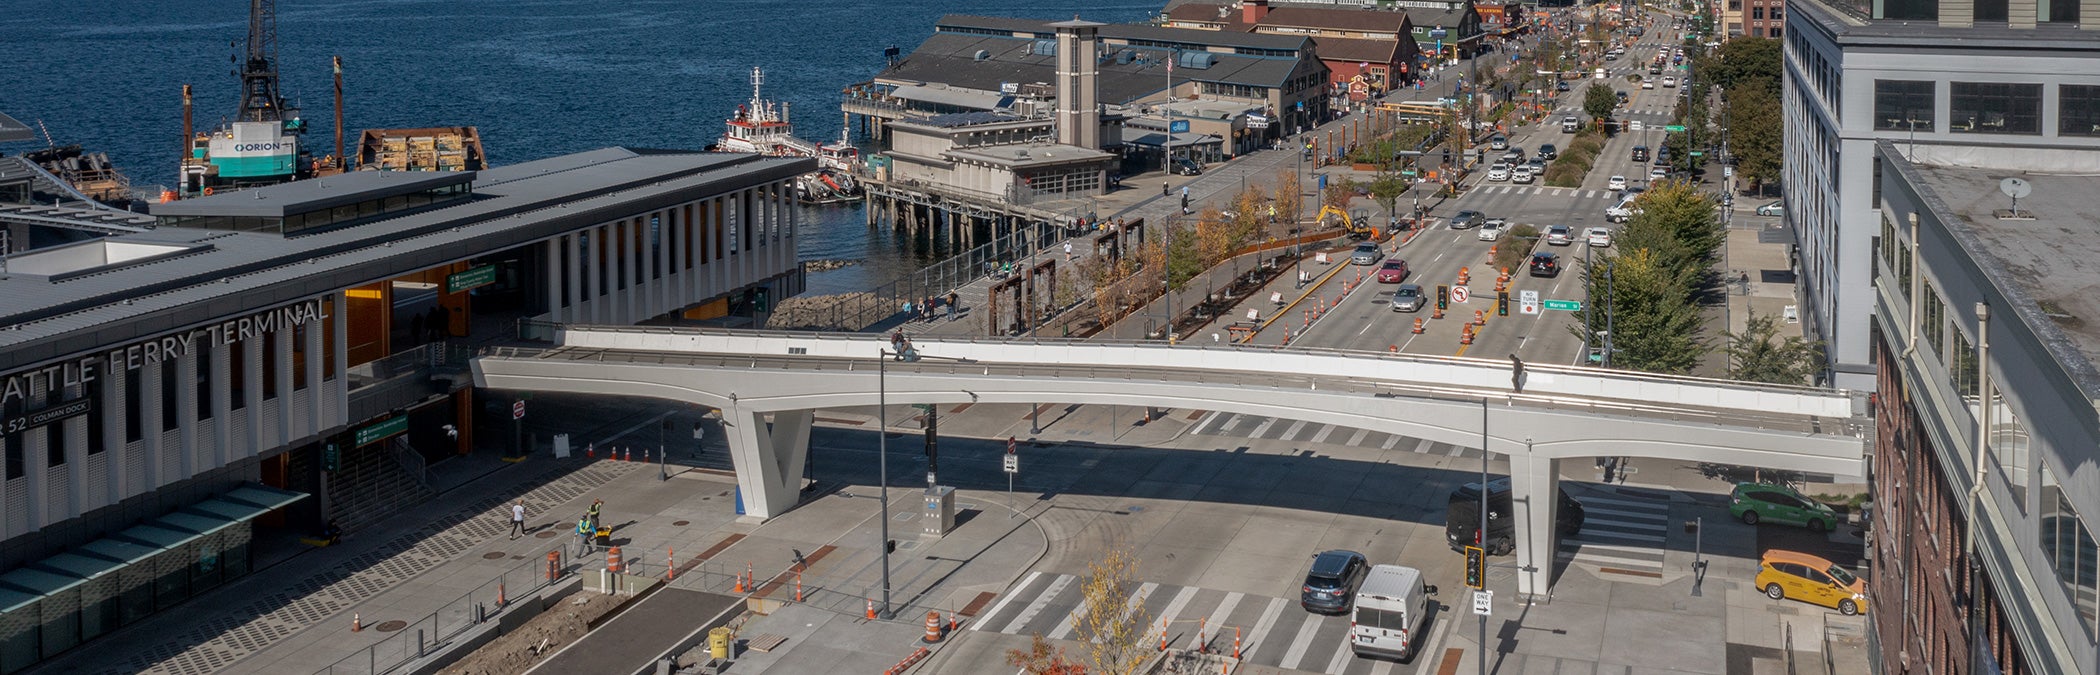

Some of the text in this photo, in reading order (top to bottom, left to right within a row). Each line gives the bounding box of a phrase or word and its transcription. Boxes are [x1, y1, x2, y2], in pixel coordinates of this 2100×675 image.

[245, 143, 280, 151] ORION
[2, 299, 329, 404] ATTLE FERRY TERMINAL
[33, 402, 87, 423] COLMAN DOCK
[9, 417, 26, 433] 52
